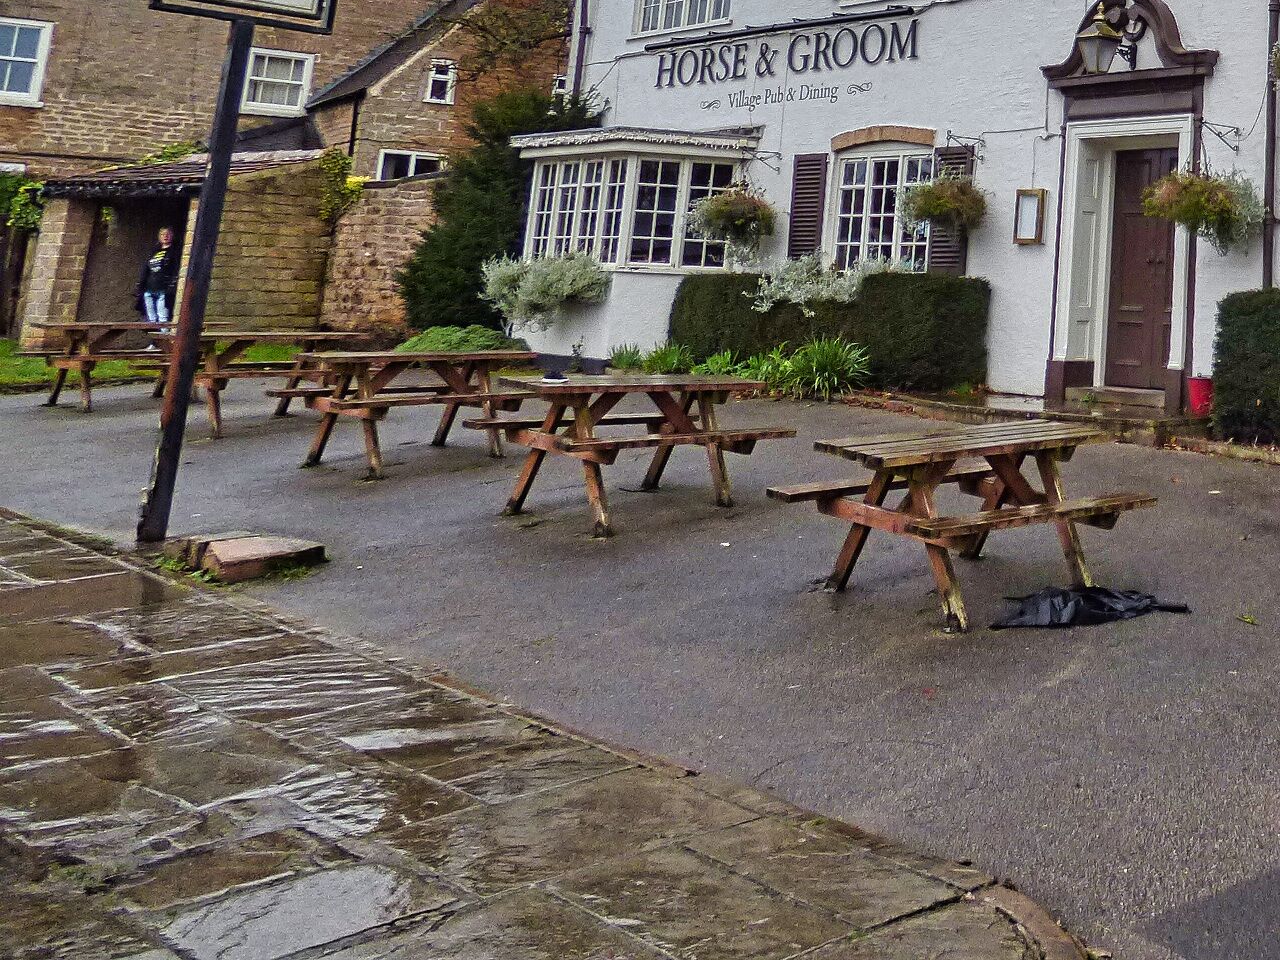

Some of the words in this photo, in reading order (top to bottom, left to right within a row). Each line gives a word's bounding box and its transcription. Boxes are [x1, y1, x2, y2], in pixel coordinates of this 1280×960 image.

[653, 43, 749, 89] HORSE
[755, 42, 779, 79] &
[787, 19, 919, 74] GROOM
[728, 89, 761, 112] Village
[764, 86, 784, 105] Pub
[786, 87, 797, 102] &
[799, 83, 839, 104] Dining
